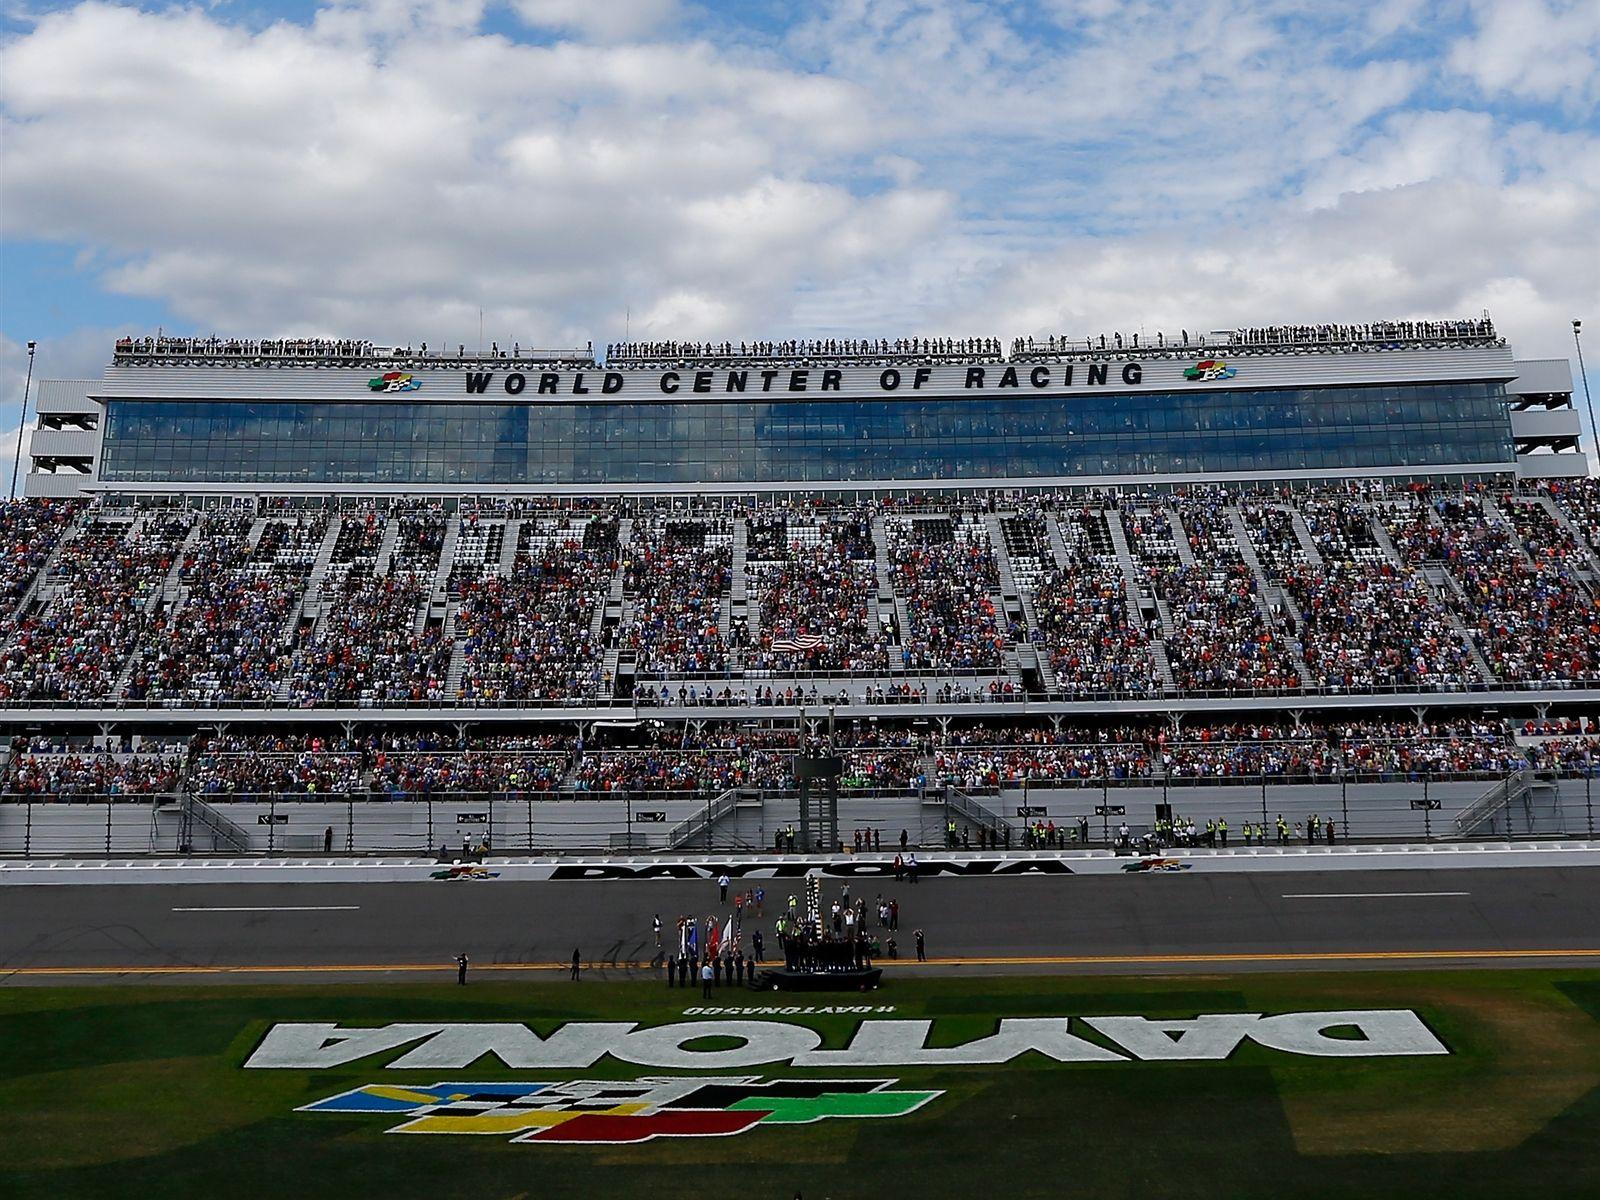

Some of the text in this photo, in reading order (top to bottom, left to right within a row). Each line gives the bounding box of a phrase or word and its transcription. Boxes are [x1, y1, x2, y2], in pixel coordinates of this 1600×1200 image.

[465, 362, 1142, 395] WORLD CENTER OF RACING
[548, 859, 1075, 880] DAYTONA
[682, 1005, 896, 1016] #DAYTONA500
[242, 1008, 1450, 1069] DAYTONA
